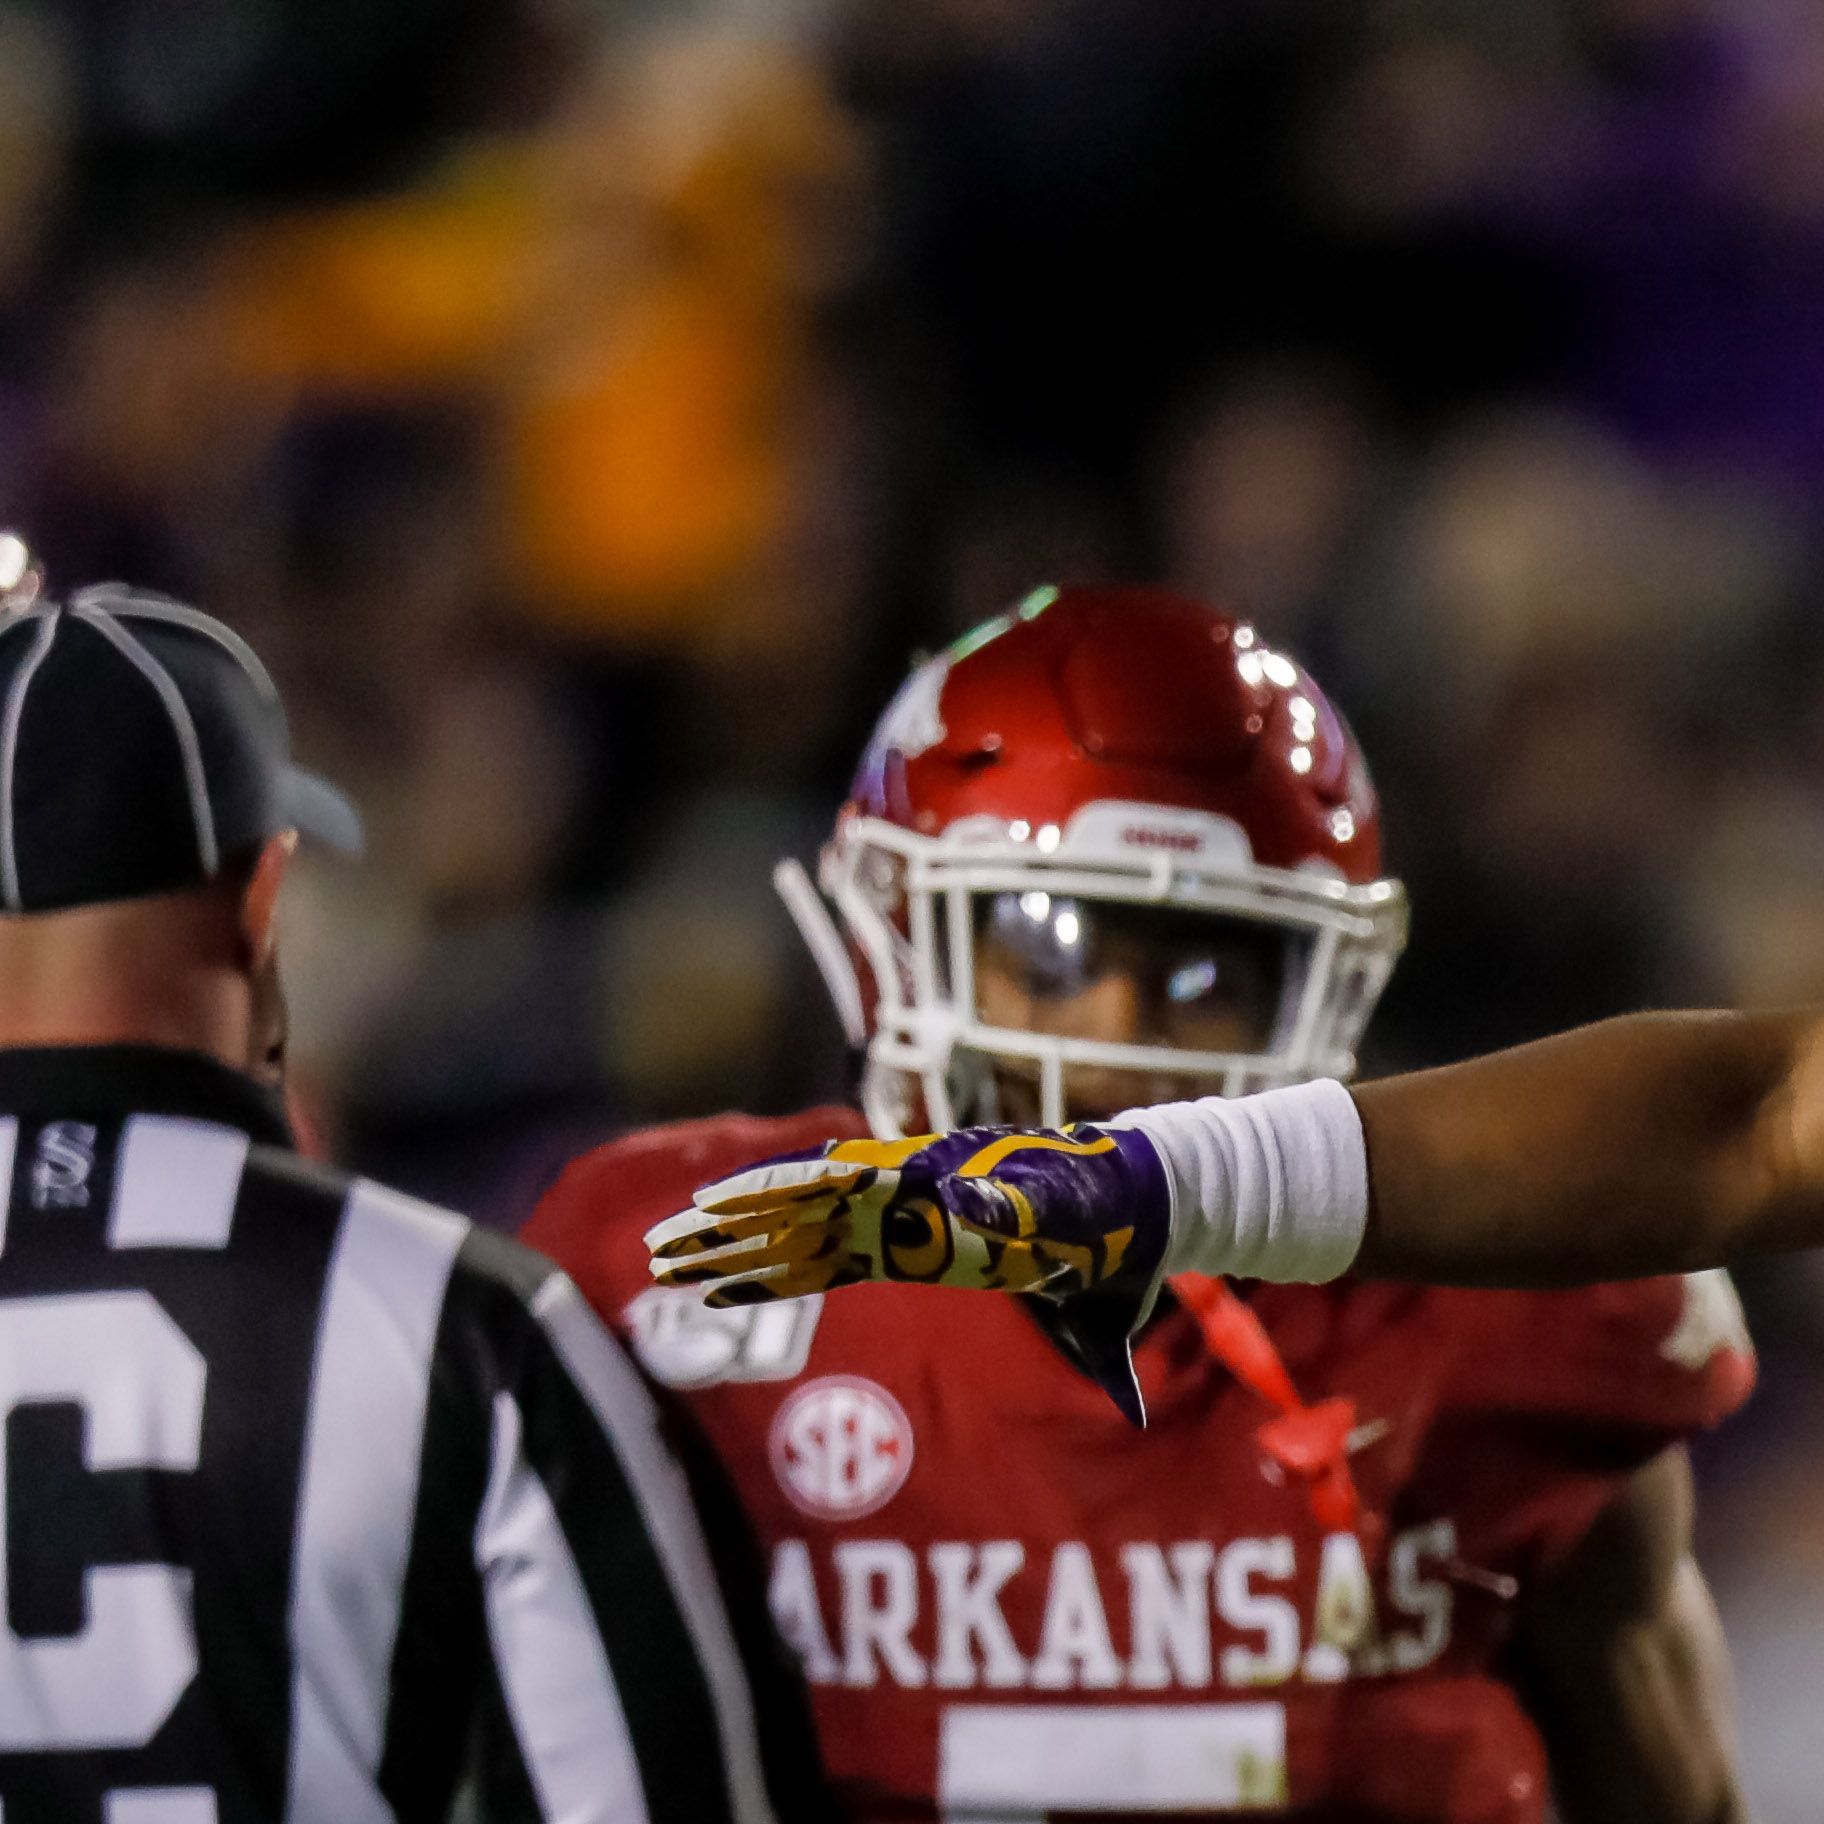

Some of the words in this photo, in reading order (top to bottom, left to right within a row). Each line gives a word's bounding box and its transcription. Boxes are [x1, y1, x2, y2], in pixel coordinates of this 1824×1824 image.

[0, 1290, 207, 1752] C
[783, 1388, 902, 1510] SEC
[767, 1520, 1460, 1690] ARKANSAS
